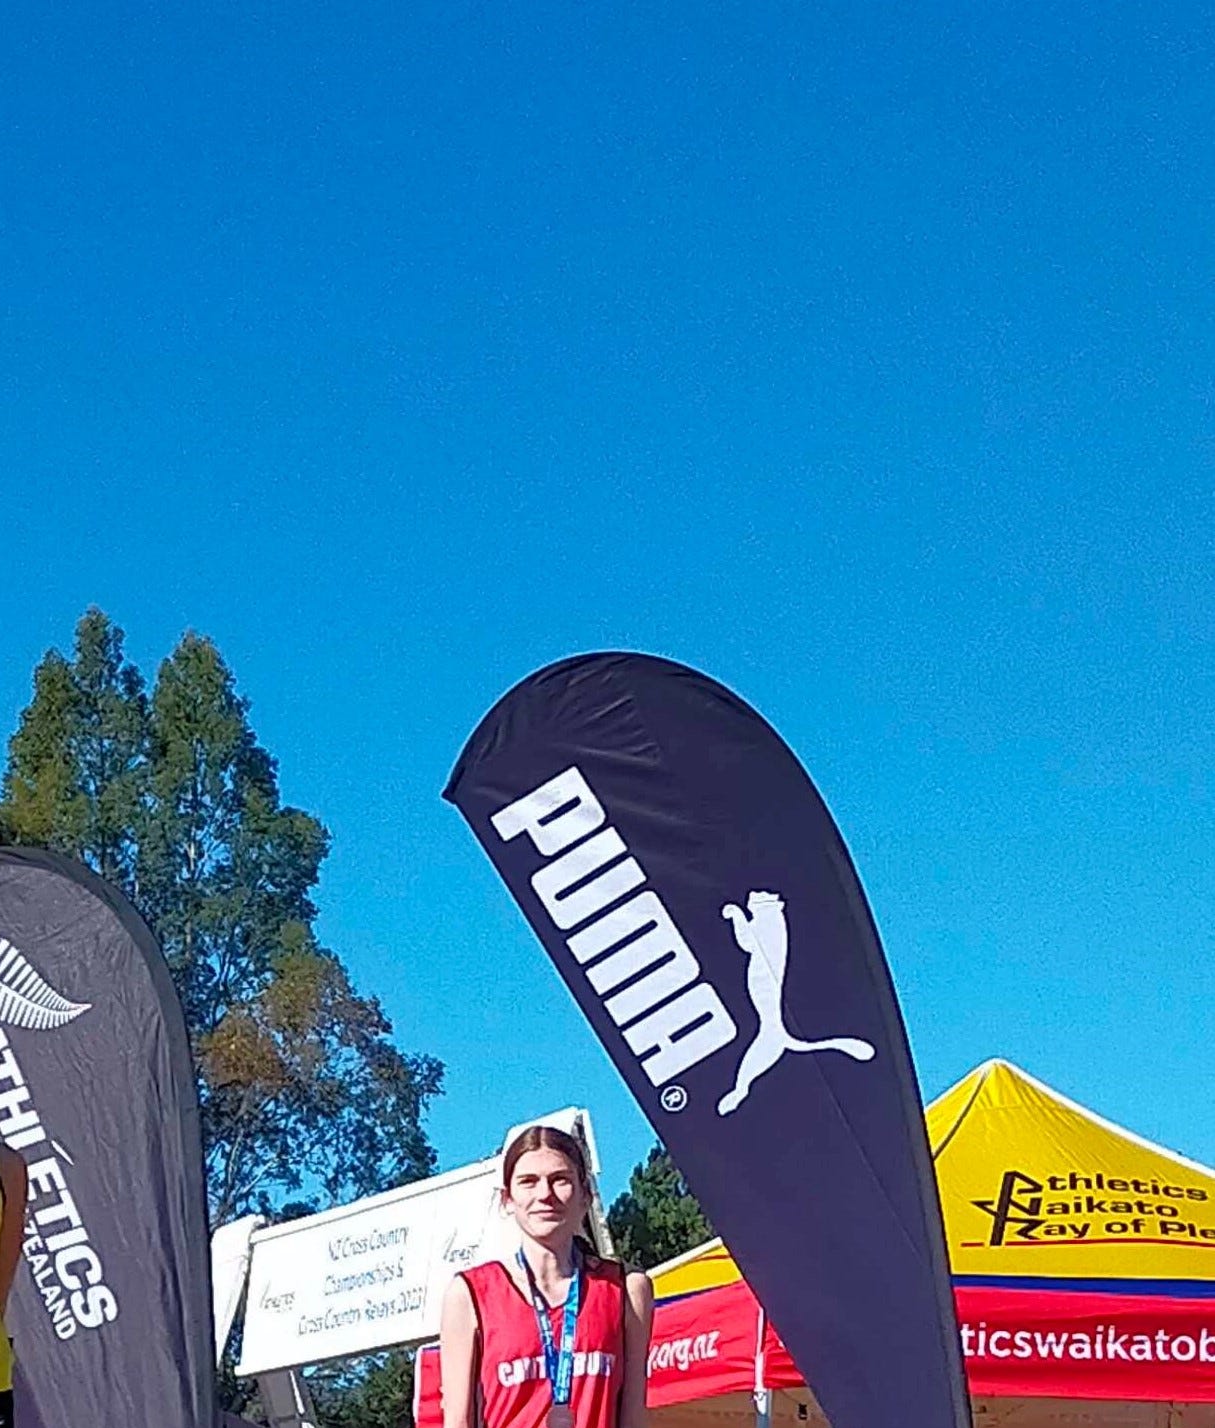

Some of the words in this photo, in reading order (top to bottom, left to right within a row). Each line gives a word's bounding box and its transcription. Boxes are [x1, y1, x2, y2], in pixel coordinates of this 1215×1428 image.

[490, 766, 737, 1087] PUMA
[1001, 1171, 1208, 1201] Athletics
[1104, 1219, 1146, 1234] of
